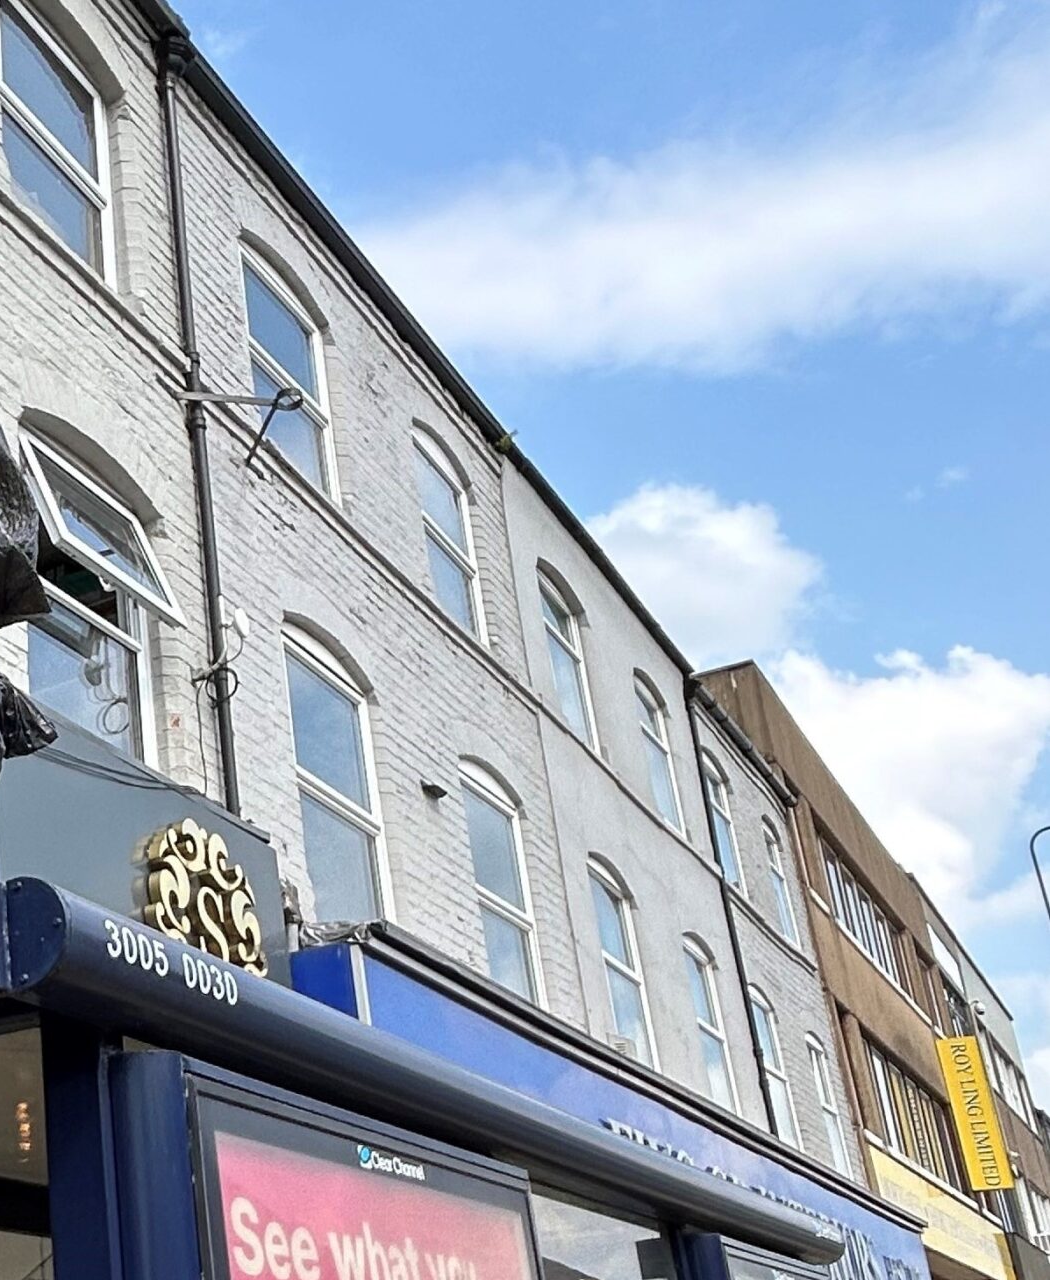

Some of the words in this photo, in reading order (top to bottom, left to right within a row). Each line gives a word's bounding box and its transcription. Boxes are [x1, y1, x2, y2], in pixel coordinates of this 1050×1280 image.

[105, 919, 169, 976] 3005
[182, 953, 238, 1005] 0030
[951, 1044, 974, 1076] ROY
[960, 1079, 983, 1117] LING
[970, 1121, 1001, 1187] LIMITED
